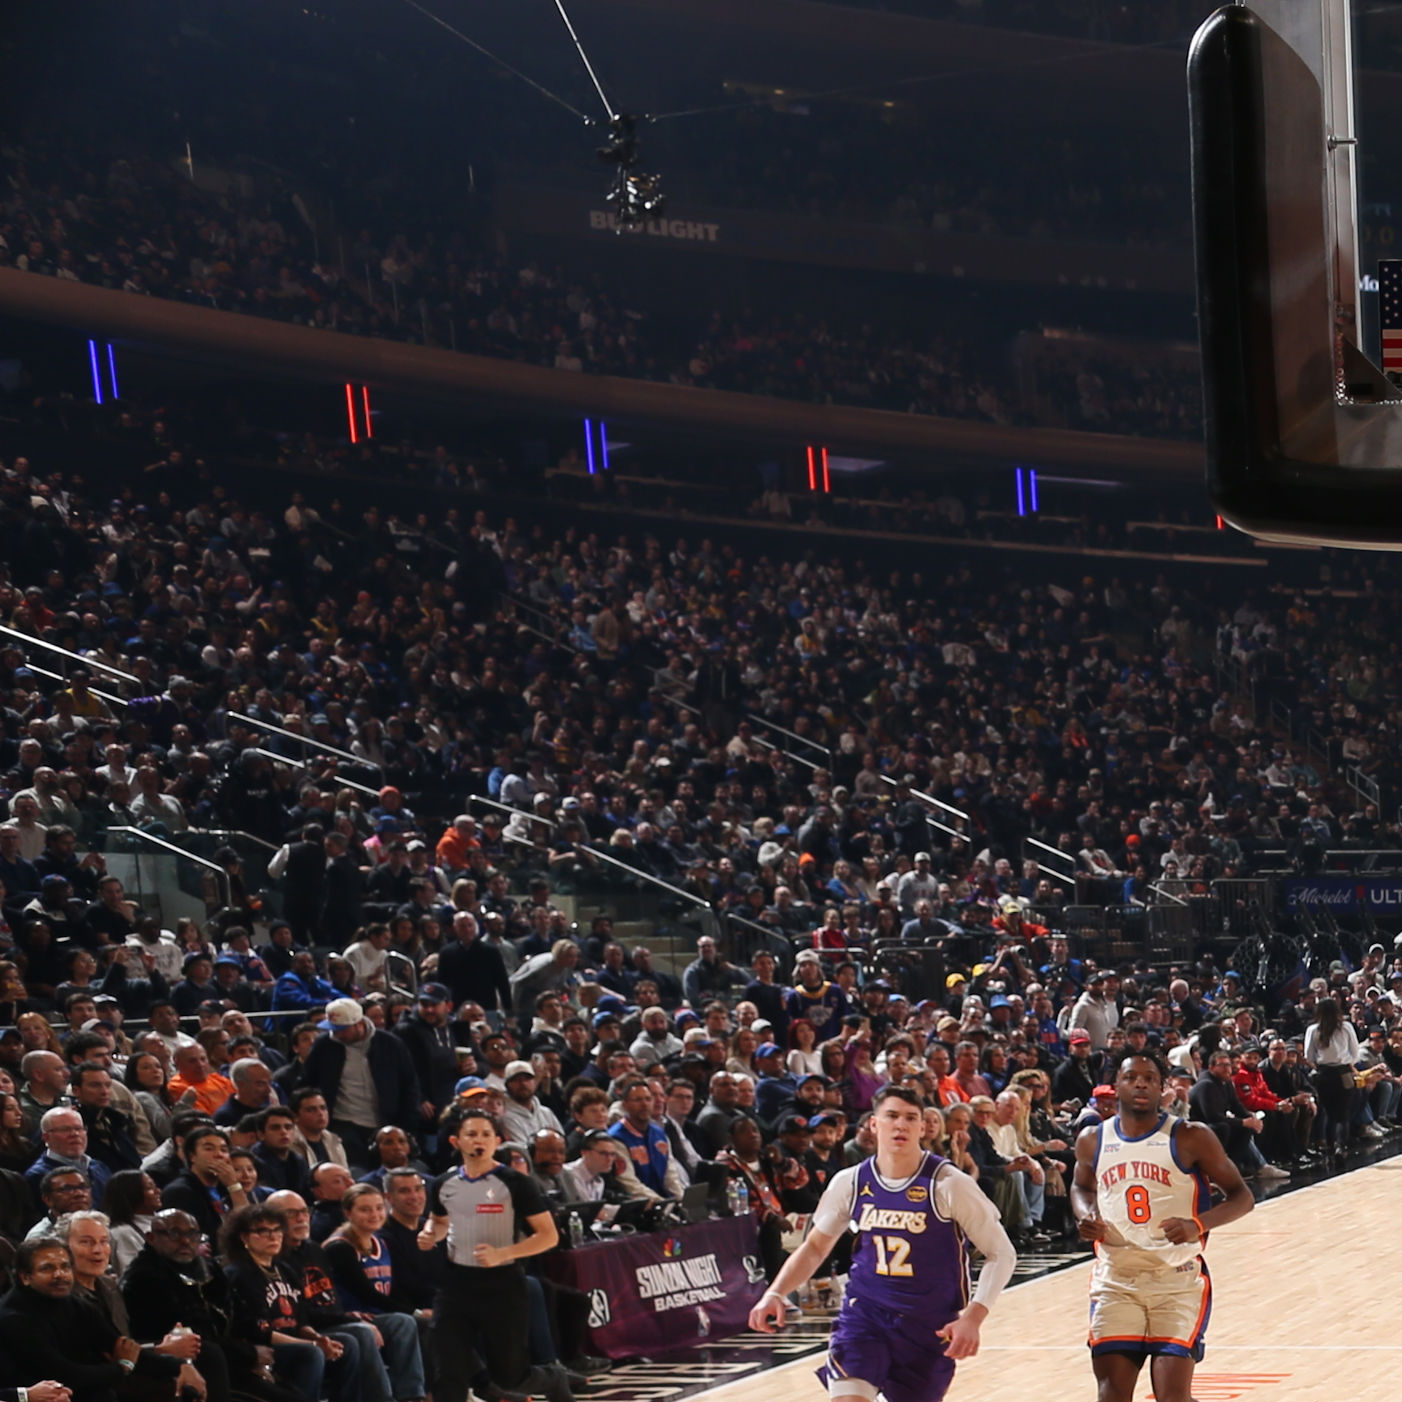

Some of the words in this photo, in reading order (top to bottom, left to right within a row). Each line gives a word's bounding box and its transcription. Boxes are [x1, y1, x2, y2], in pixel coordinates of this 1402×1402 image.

[646, 218, 720, 242] LIGHT
[1101, 1162, 1128, 1190] NEW
[1130, 1160, 1173, 1187] YORK
[858, 1203, 928, 1234] LAKERS
[1126, 1184, 1151, 1225] 8
[872, 1234, 914, 1278] 12
